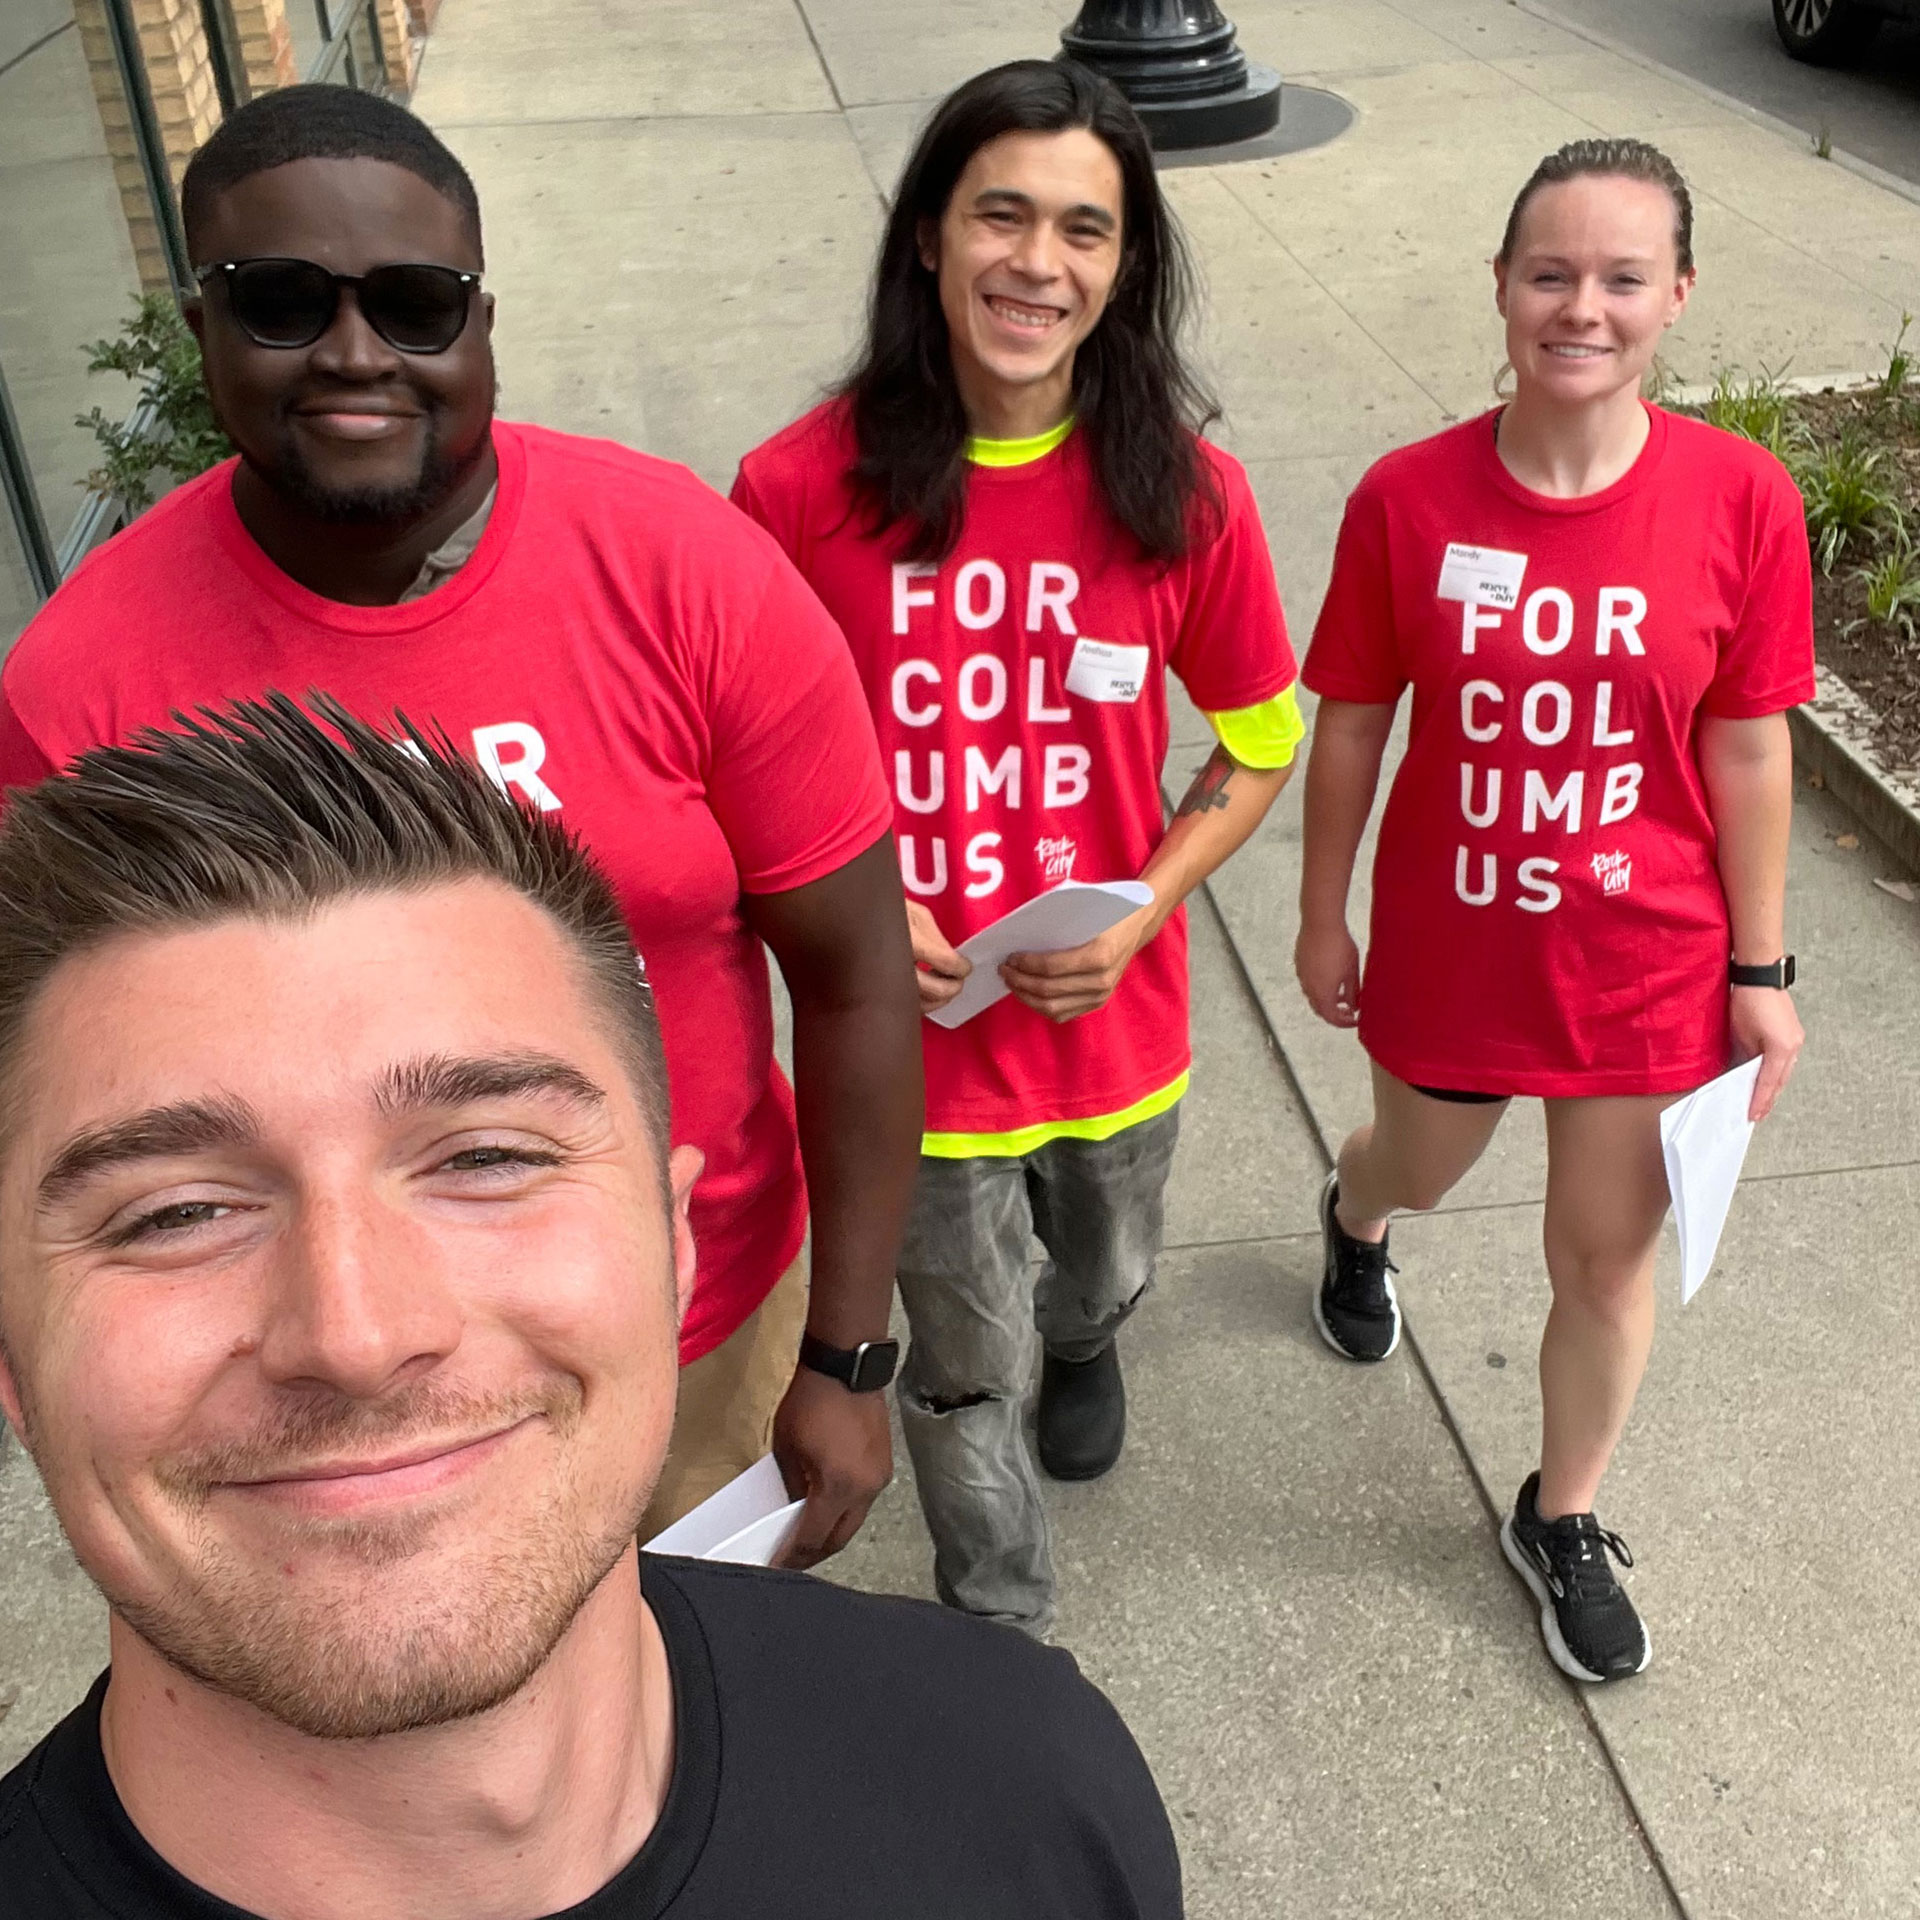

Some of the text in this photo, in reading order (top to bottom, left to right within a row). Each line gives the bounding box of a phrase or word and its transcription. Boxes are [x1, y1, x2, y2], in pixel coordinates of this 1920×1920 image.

[892, 559, 1079, 635] FOR
[1461, 586, 1649, 656] FOR
[891, 653, 1072, 727] COL
[1461, 679, 1635, 747] COL
[895, 743, 1092, 815] UMB
[1460, 762, 1644, 834] UMB
[899, 831, 1005, 898] US
[1454, 844, 1563, 913] US
